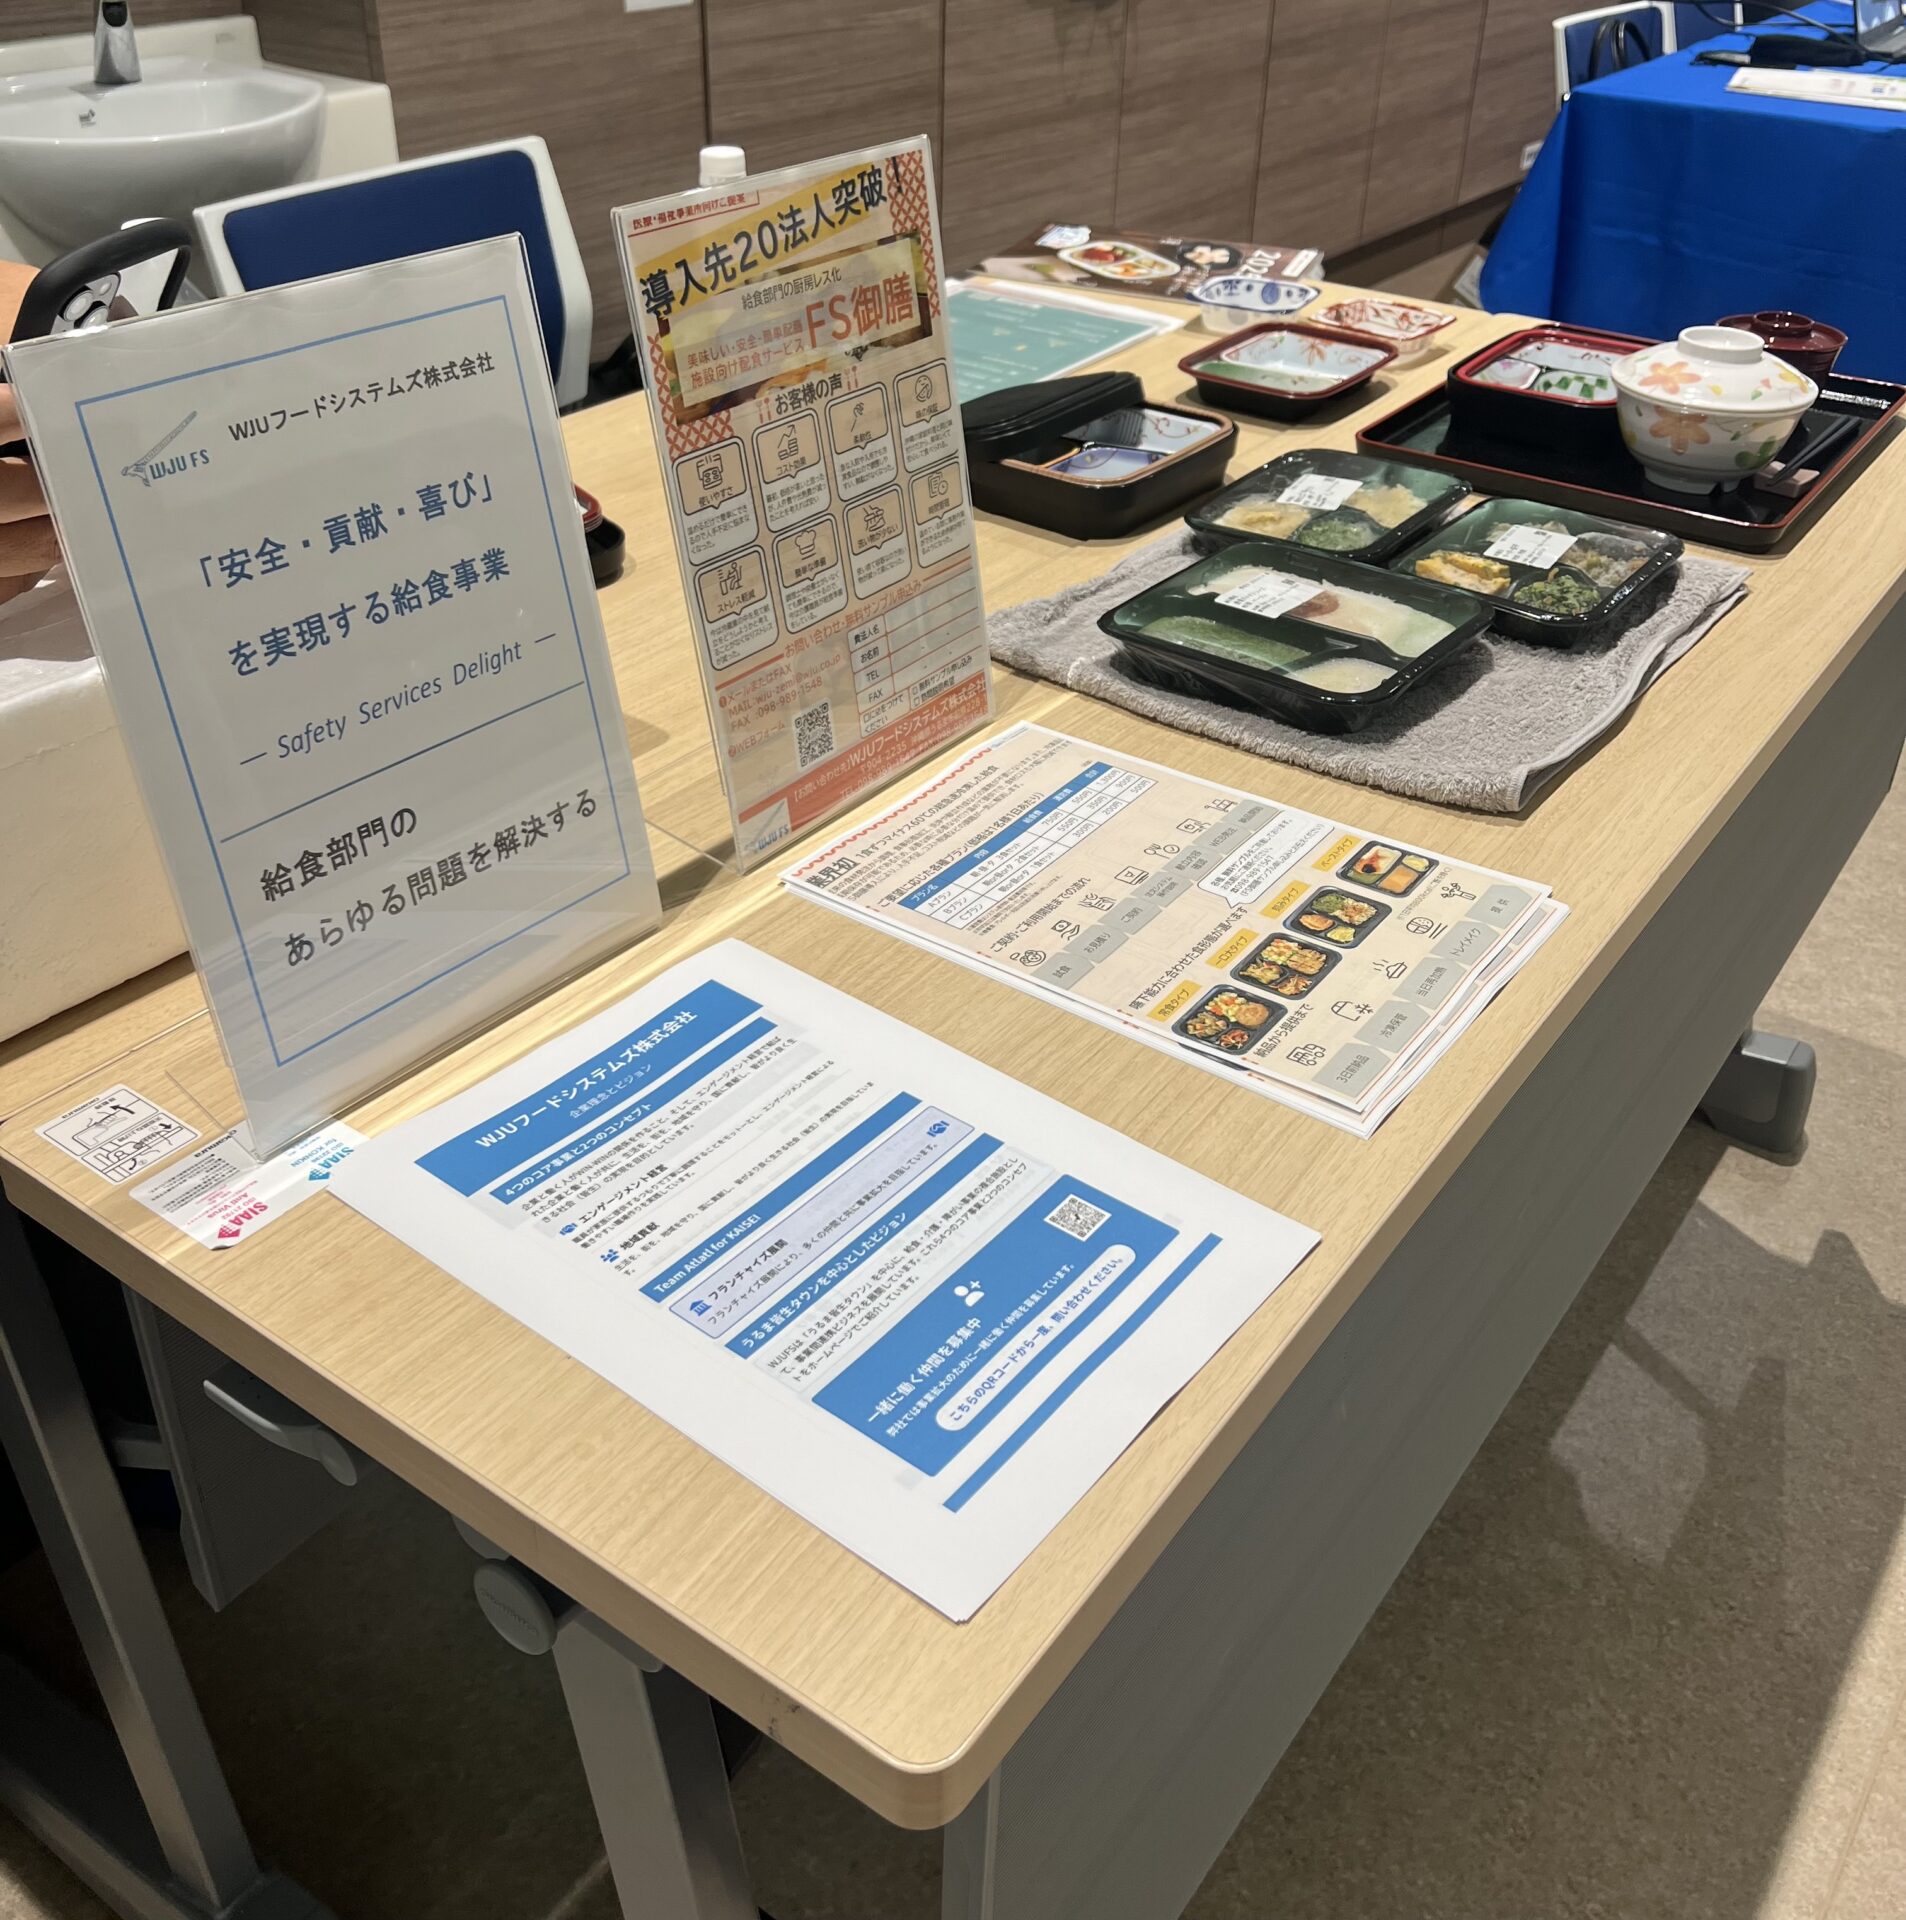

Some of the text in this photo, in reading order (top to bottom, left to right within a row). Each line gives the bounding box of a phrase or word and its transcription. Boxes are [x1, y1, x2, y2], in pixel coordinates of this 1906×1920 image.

[742, 266, 842, 311] 給食部門の厨房レス化
[805, 273, 914, 349] FS御膳
[690, 338, 805, 389] 施設向け配食サービス
[228, 350, 496, 443] WJUフードシステムズ株式会社
[775, 372, 844, 416] お客様の声
[189, 448, 211, 470] FS
[697, 484, 734, 508] 使いやすさ
[199, 470, 496, 590] 「安全・貢献・喜び」
[228, 546, 511, 678] を実現する給食事業
[716, 588, 756, 615] ストレス軽減
[853, 622, 880, 645] 貴法人名
[859, 644, 880, 665] お名前
[865, 667, 880, 683] TEL
[867, 686, 883, 703] FAX
[277, 640, 522, 761] Safety Services Delight
[259, 806, 418, 903] 給食部門の
[802, 855, 861, 889] 業界初
[1316, 837, 1356, 868] ペーストタイプ
[284, 787, 598, 968] あらゆる問題を解決する
[909, 883, 940, 902] プラン名
[971, 848, 991, 859] 内容
[925, 890, 954, 908] Aプラン
[941, 896, 970, 914] Bプラン
[957, 902, 985, 921] Cプラン
[986, 875, 1094, 953] ご契約・ご利用開始までの流れ
[1118, 906, 1144, 923] ご契約
[1081, 931, 1113, 954] お見積り
[1125, 905, 1252, 1011] 嚥下能力に合わせた食形態が選べます
[1210, 935, 1251, 967] 一口大タイプ
[1448, 926, 1483, 957] トレイメイク
[1050, 964, 1073, 978] 試食
[1412, 965, 1449, 997] 当日再加熱
[1156, 988, 1193, 1017] 常食タイプ
[1251, 1001, 1316, 1059] 納品から提供まで
[1376, 1011, 1409, 1039] 冷凍保管
[473, 1008, 699, 1149] WJUフードシステムズ株式会社
[1335, 1052, 1371, 1084] 3日前納品
[566, 1062, 656, 1119] 企業理念とビジョン
[318, 1146, 354, 1170] SIAA
[502, 1102, 654, 1197] 4つのコア事業と2つのコンセプト
[207, 1203, 232, 1219] Virus
[577, 1162, 669, 1224] エンゲージメント経営
[229, 1201, 269, 1226] SIAA
[617, 1220, 661, 1251] 地域貢献
[653, 1212, 763, 1294] Team Atlatl for KAISEI
[706, 1237, 790, 1302] フランチャイズ展開
[738, 1210, 911, 1350] うるま皆生タウンを中心としたビジョン
[791, 1272, 922, 1383] トをホームページでご紹介しています。
[945, 1254, 1125, 1422] こちらのQRコードから一度、問い合わせください。
[884, 1261, 1076, 1438] 弊社では事業拡大のために一緒に働く仲間を募集しています。
[862, 1315, 986, 1426] 一緒に働く仲間を募集中
